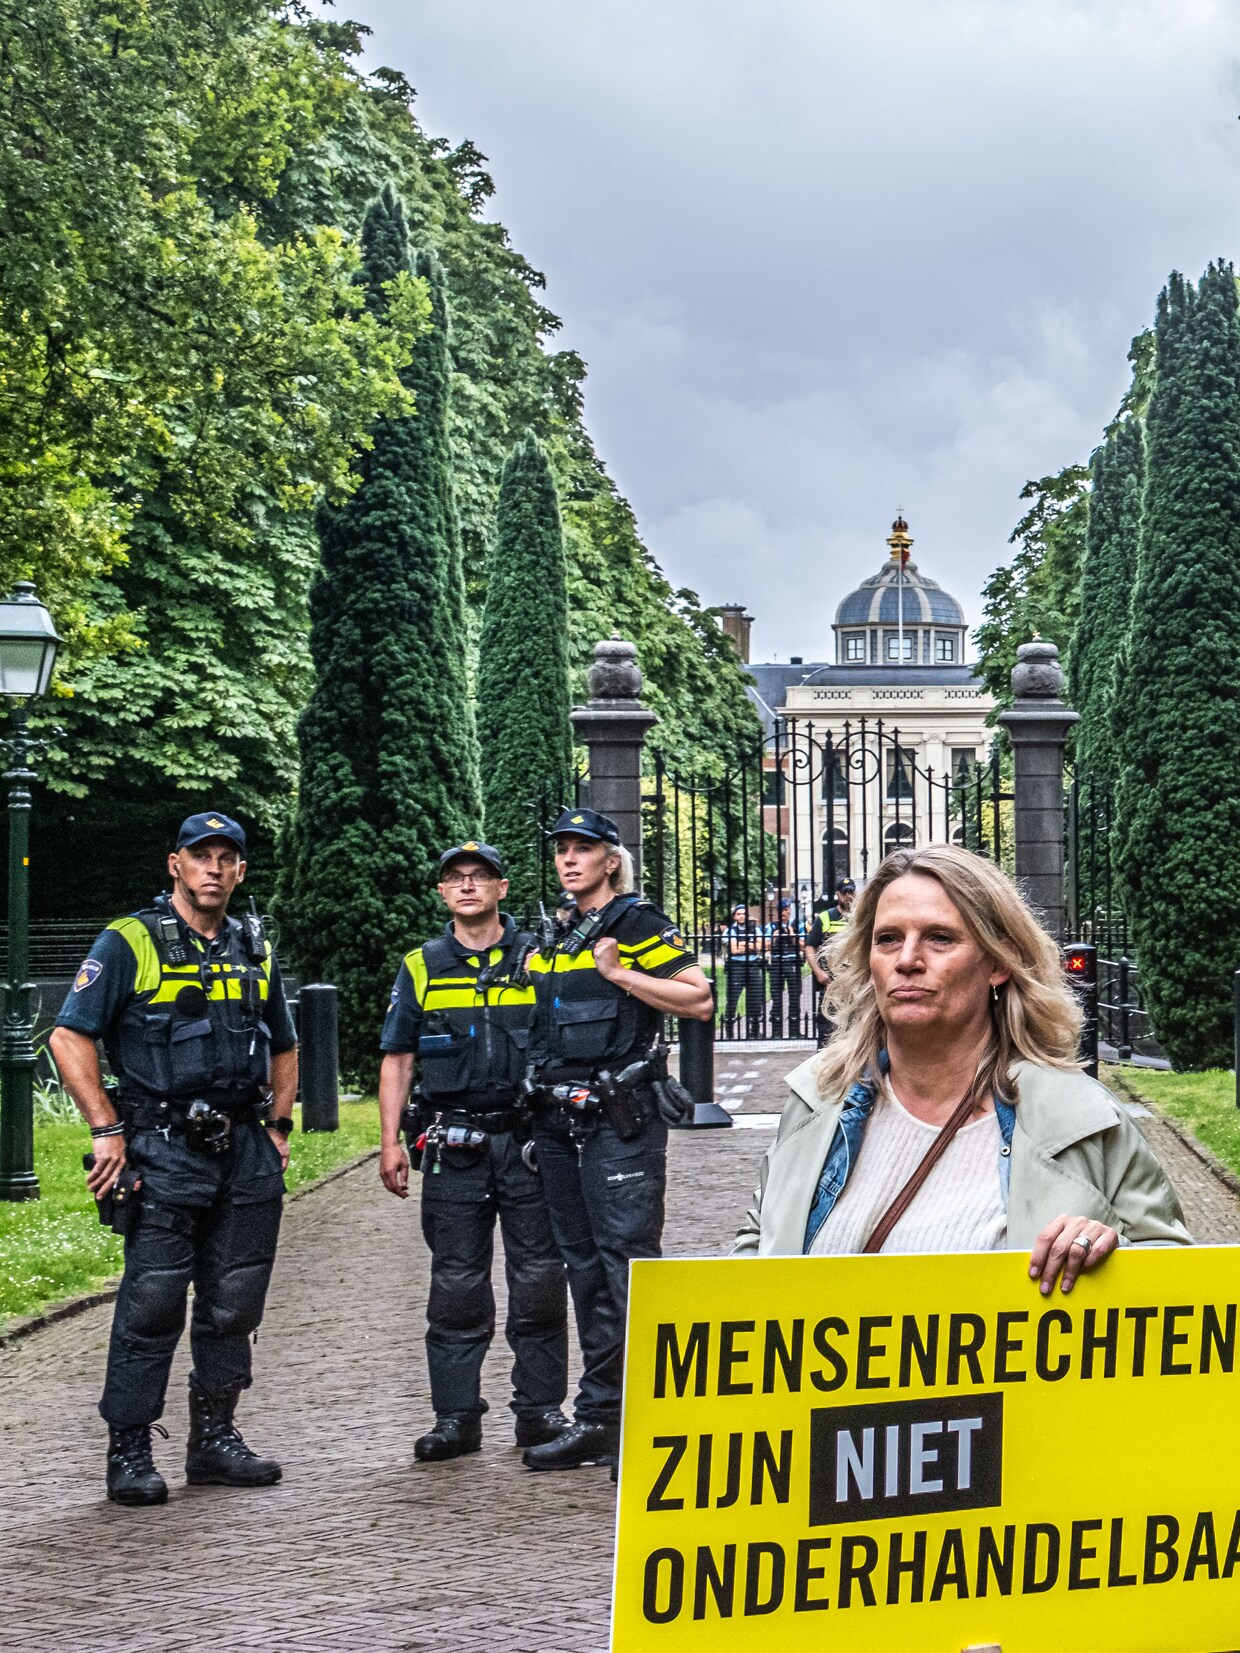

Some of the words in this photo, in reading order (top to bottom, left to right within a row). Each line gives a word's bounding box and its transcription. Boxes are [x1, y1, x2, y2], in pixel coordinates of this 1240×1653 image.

[653, 1303, 1238, 1399] MENSENRECHTEN
[646, 1429, 793, 1512] ZIJN
[835, 1416, 983, 1503] NIET
